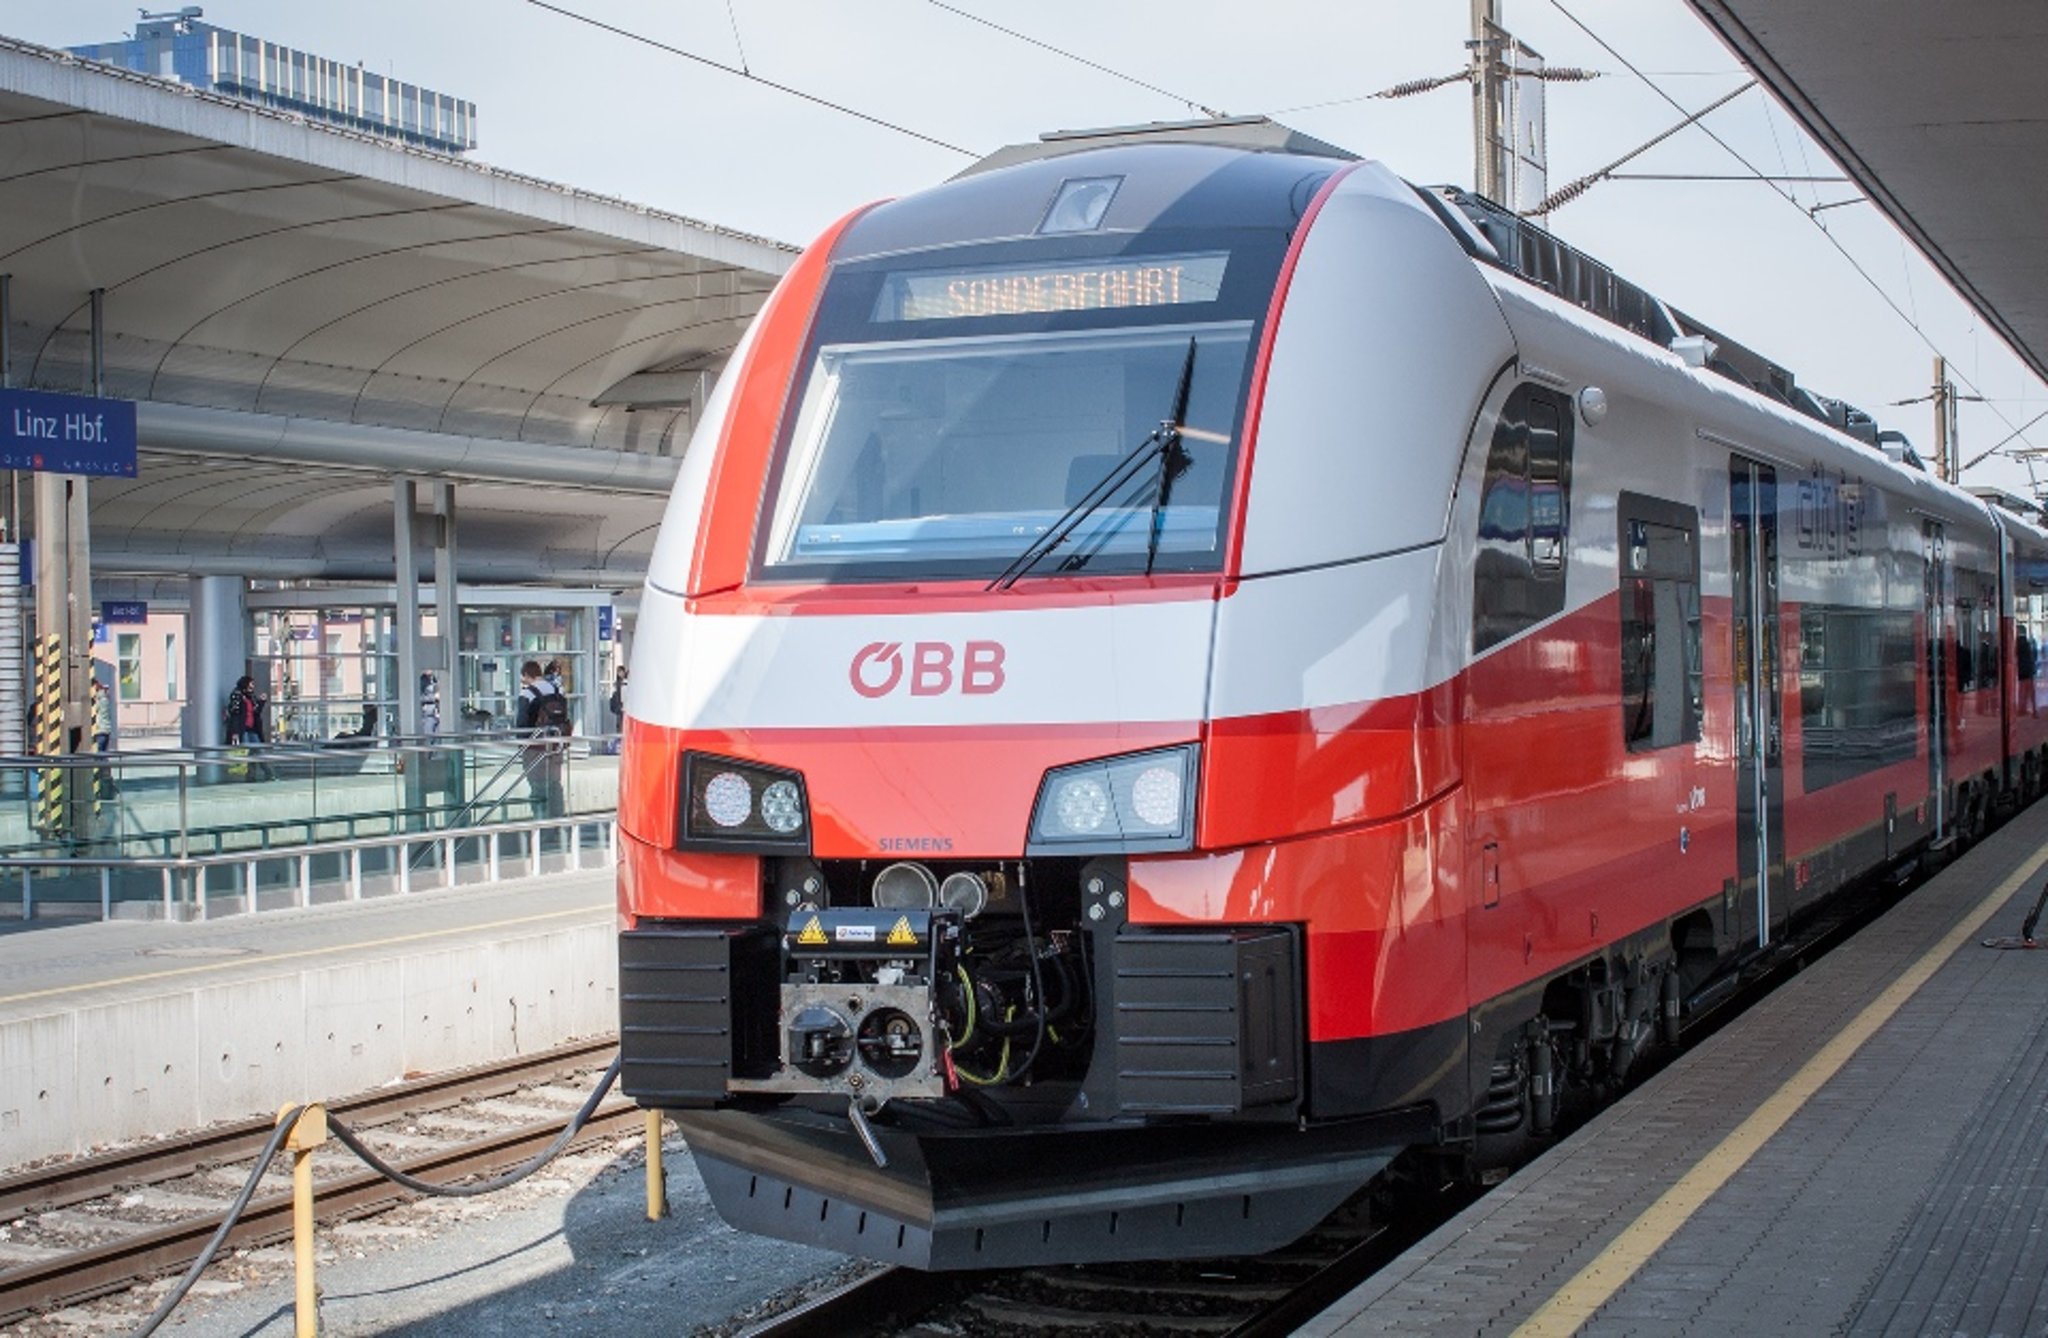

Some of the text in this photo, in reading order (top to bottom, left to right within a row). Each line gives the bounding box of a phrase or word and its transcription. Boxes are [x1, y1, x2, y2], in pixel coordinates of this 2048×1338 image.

[948, 265, 1184, 317] SONDERFAHRT
[14, 408, 108, 443] Linz Hbf.
[849, 640, 1006, 698] ÖBB
[879, 837, 953, 852] SIEMENS
